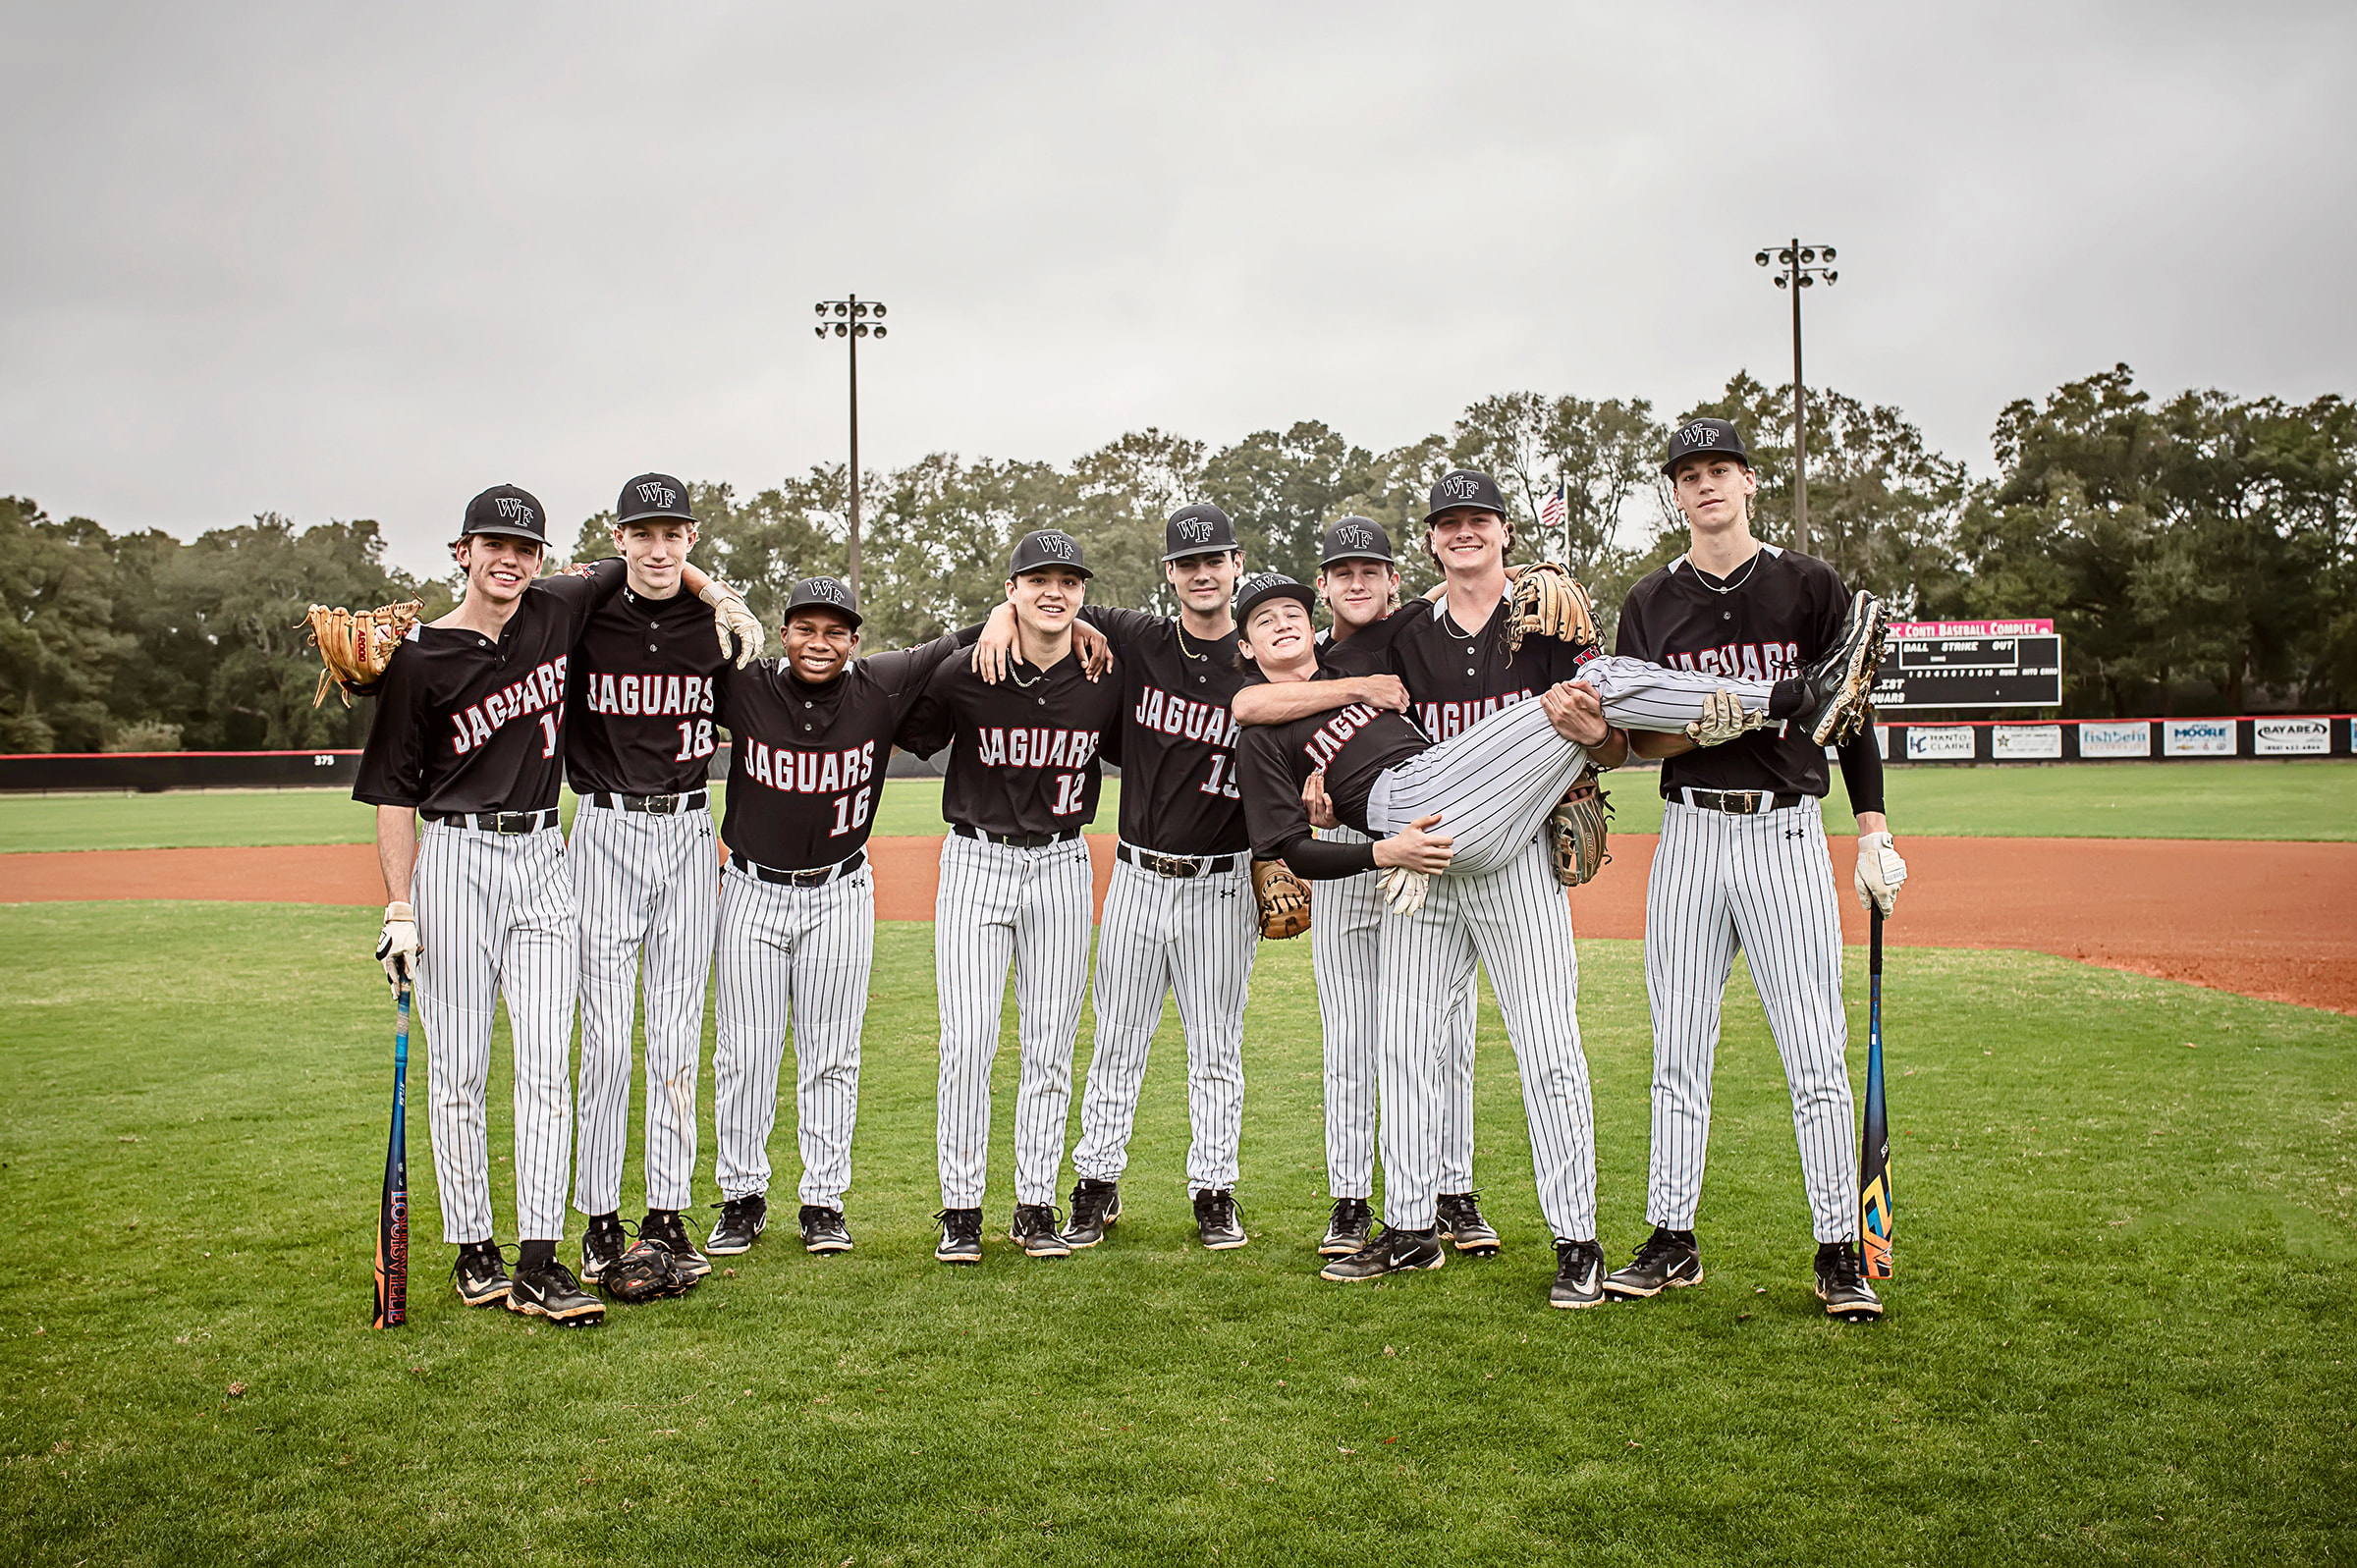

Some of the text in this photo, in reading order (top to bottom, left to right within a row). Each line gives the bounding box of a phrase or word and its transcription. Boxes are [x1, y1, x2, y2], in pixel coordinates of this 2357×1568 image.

[1679, 423, 1719, 447] WF
[636, 482, 676, 508] WF
[1442, 475, 1479, 499] WF
[495, 498, 533, 526] WF
[1177, 517, 1213, 543] WF
[1336, 524, 1373, 549] WF
[1037, 535, 1073, 561] WF
[808, 580, 845, 604] WF
[1905, 624, 1935, 637] CONTI
[1939, 623, 1985, 636] BASEBALL
[1990, 622, 2037, 635] COMPLEX
[1903, 643, 1929, 653] BALL
[1941, 641, 1979, 652] STRIKE
[1992, 640, 2013, 651] OUT
[587, 672, 714, 716] JAGUARS
[675, 718, 714, 762] 18
[2084, 729, 2146, 743] fishbein
[2174, 727, 2226, 737] MOORE
[2263, 725, 2321, 734] BAY AREA
[314, 754, 334, 766] 375
[977, 727, 1100, 770] JAGUARS
[744, 736, 875, 793] JAGUARS
[1051, 772, 1086, 816] 12
[829, 784, 871, 838] 16
[388, 1190, 409, 1325] LOUISVILLE
